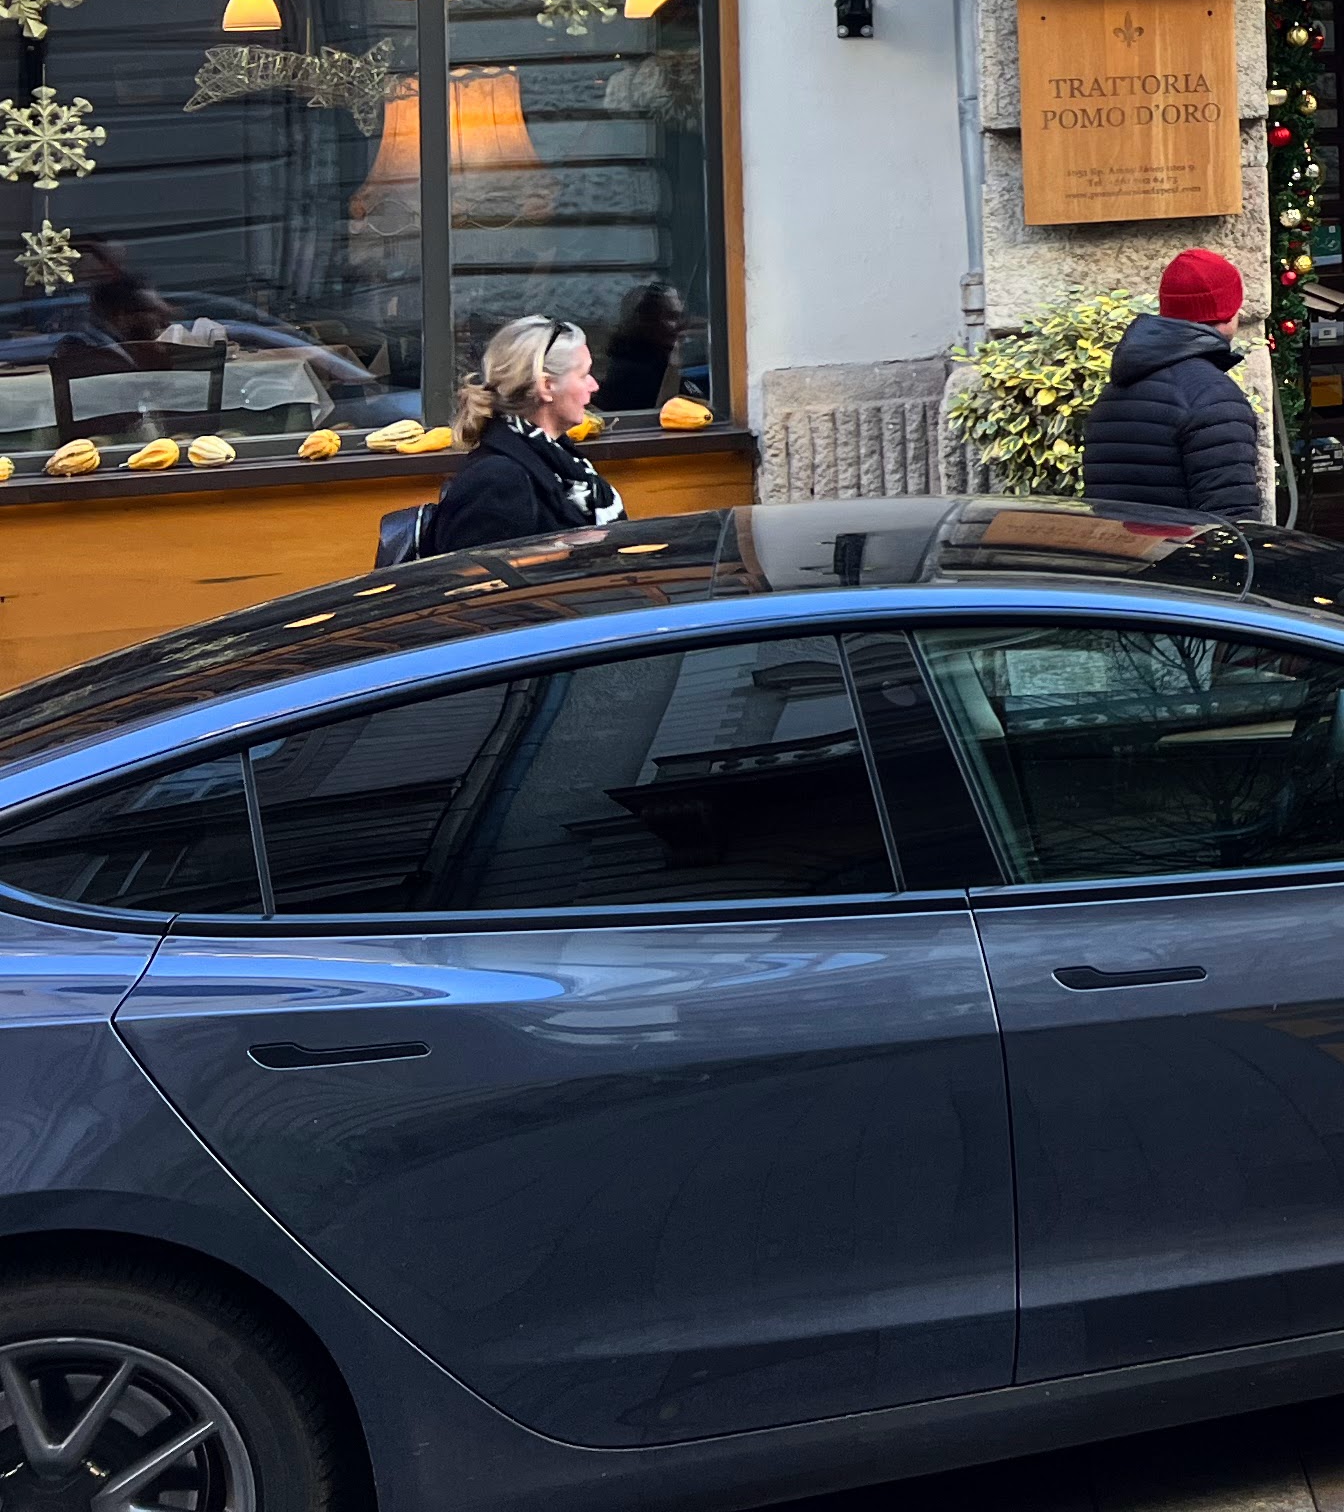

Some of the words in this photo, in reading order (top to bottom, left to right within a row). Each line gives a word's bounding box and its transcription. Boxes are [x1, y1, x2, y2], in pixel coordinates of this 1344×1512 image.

[1048, 72, 1213, 99] TRATTORIA
[1041, 106, 1126, 131] POMO
[1135, 101, 1222, 126] D'ORO
